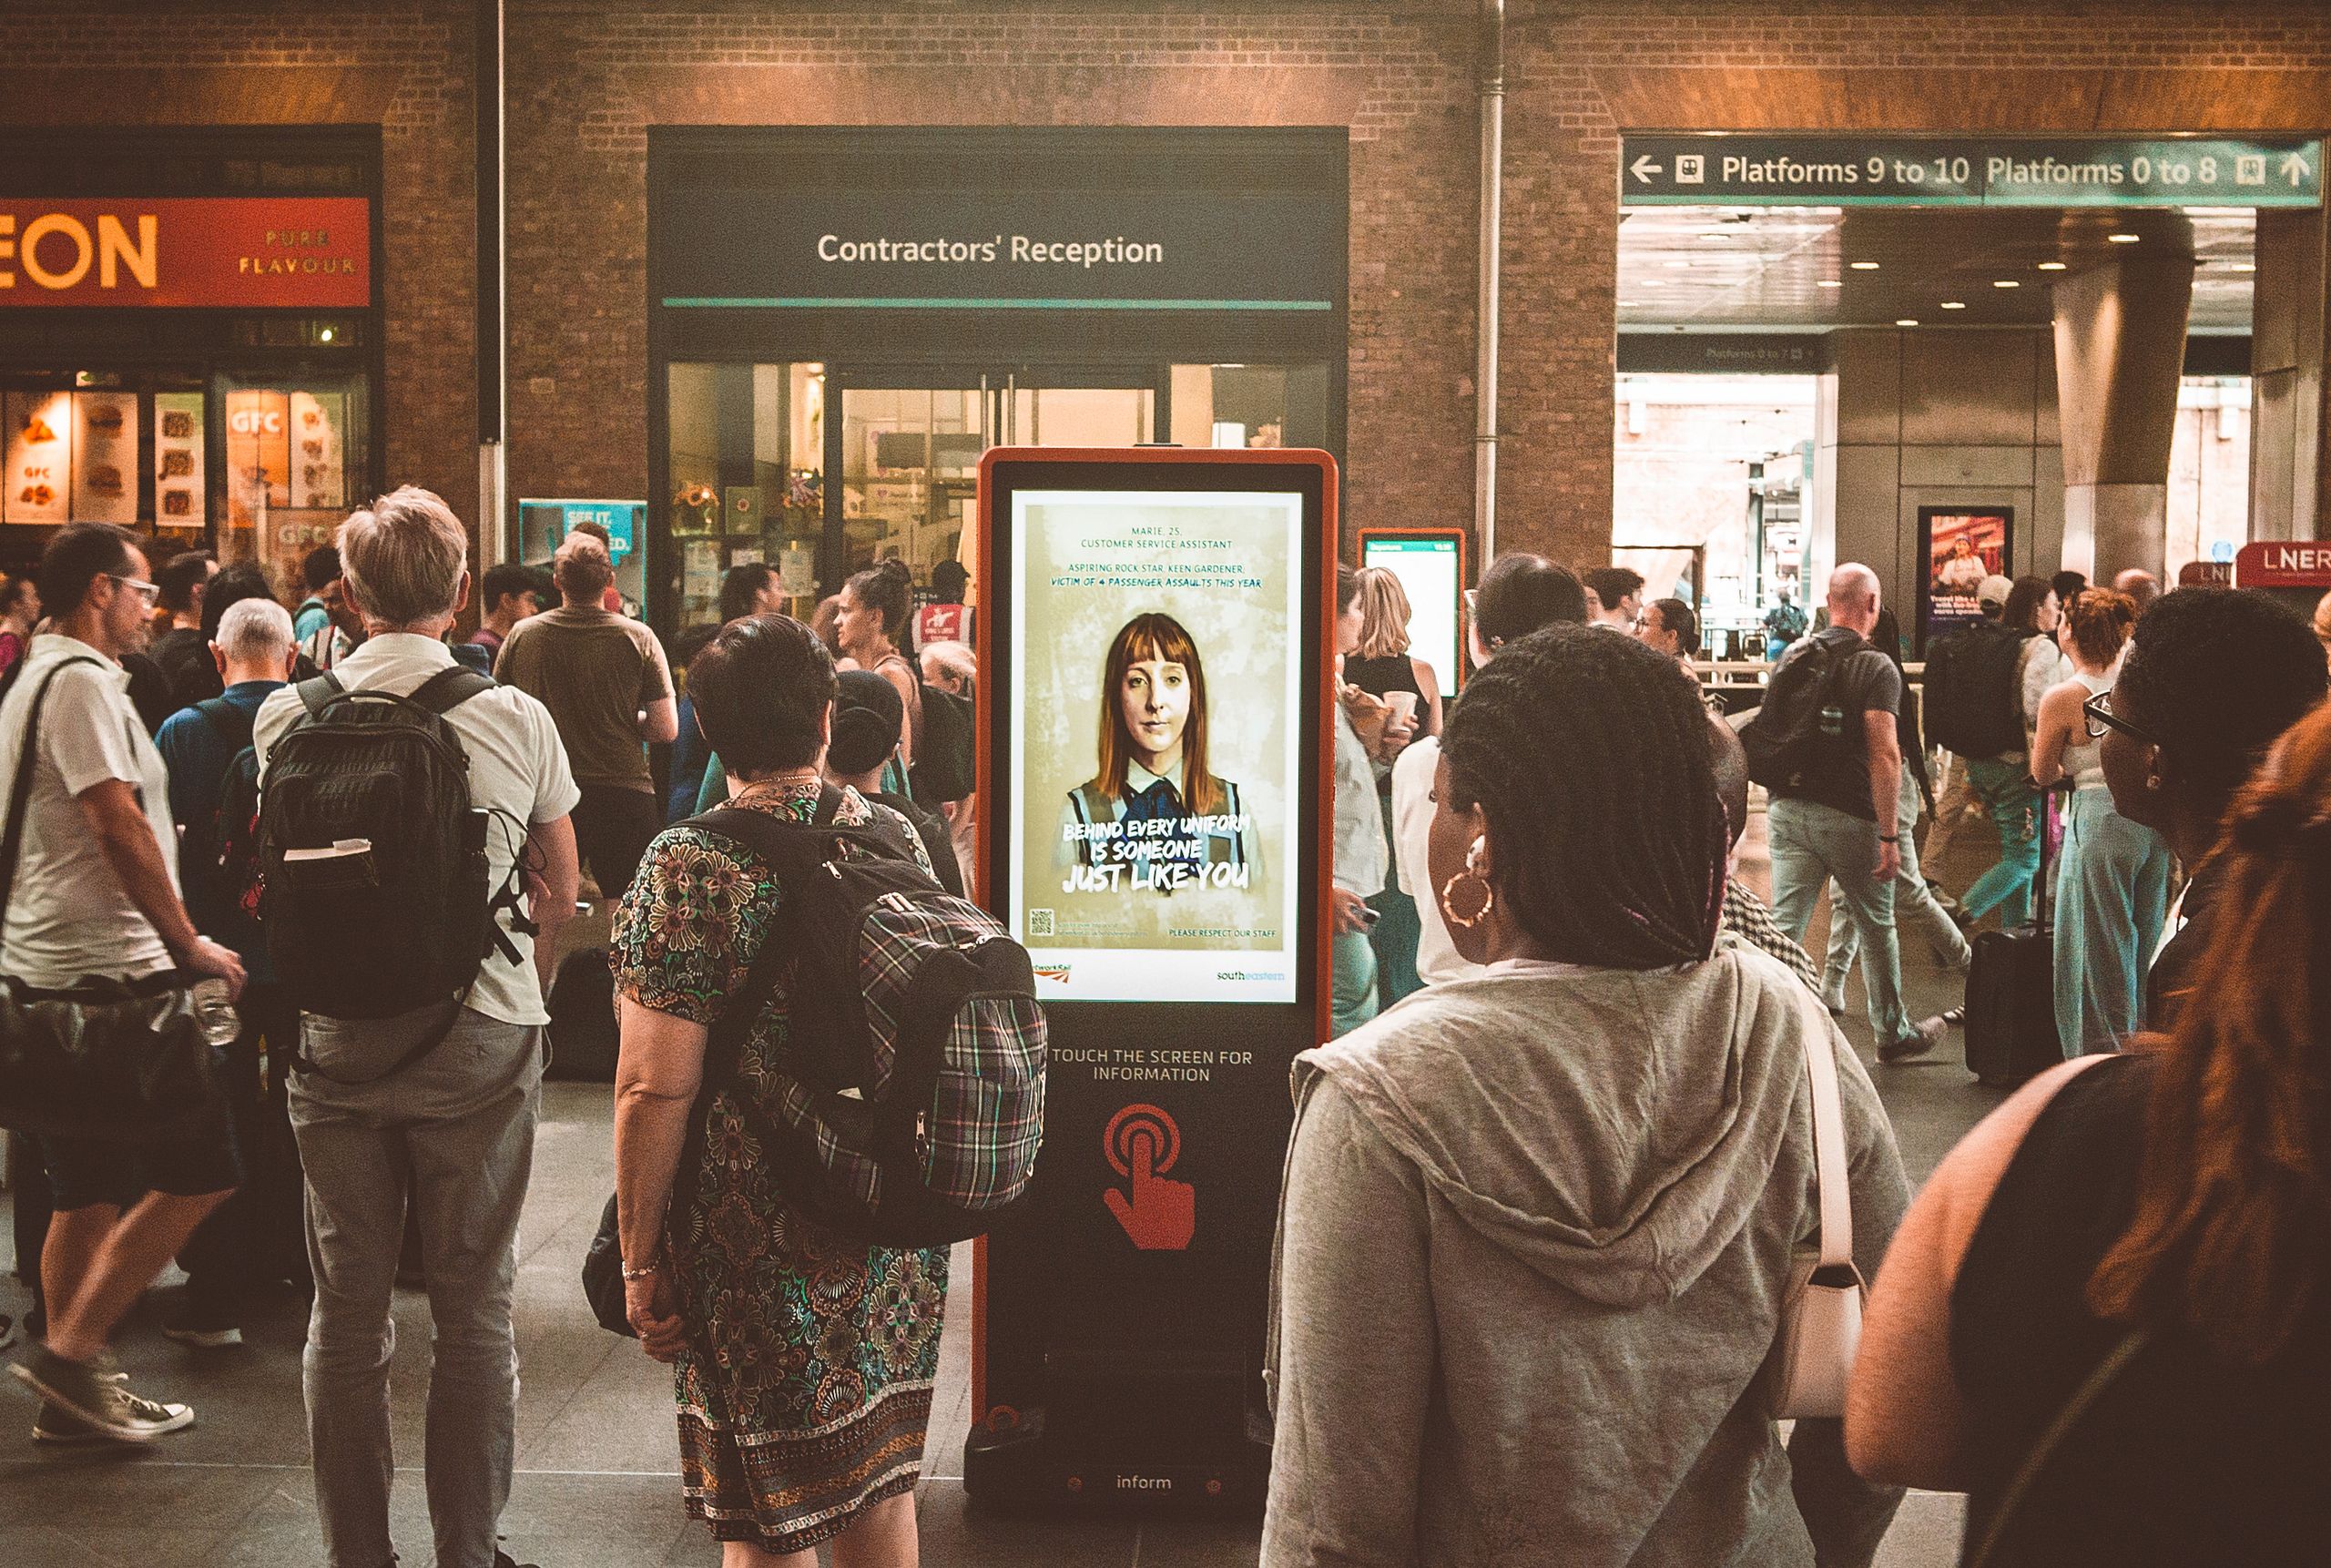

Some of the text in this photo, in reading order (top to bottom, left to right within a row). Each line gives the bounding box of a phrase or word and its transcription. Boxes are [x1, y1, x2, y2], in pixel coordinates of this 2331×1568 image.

[1723, 157, 1970, 183] Platforms 9 to 10
[1988, 157, 2217, 184] Platforms 0 to 8
[265, 229, 330, 248] PURE
[818, 234, 1163, 268] Contractors' Reception
[239, 257, 357, 274] FLAVOUR
[230, 411, 281, 433] GFC
[24, 466, 50, 479] GFC
[1081, 539, 1233, 549] CUSTOMER SERVICE ASSISTANT
[2264, 546, 2331, 571] LNER
[1068, 564, 1113, 574] ASPIRING
[1115, 564, 1138, 574] ROCK
[1168, 565, 1192, 574] KEEN
[1051, 576, 1081, 586] VICTIM
[1084, 577, 1094, 586] OF
[1108, 577, 1163, 587] PASSENGER
[1166, 577, 1212, 587] ASSAULTS
[1216, 578, 1235, 587] THIS
[1238, 578, 1263, 587] YEAR
[1063, 813, 1251, 841] BEHIND EVERY UNIFORM
[1091, 839, 1203, 861] IS SOMEONE
[1062, 861, 1249, 893] JUST LIKE YOU
[1169, 929, 1196, 937] PLEASE
[1198, 929, 1231, 938] RESPECT
[1253, 930, 1276, 938] STAFF
[1216, 971, 1285, 981] southeastern
[1053, 1048, 1253, 1064] TOUCH THE SCREEN FOR
[1094, 1067, 1209, 1082] INFORMATION
[1116, 1475, 1172, 1489] inform
